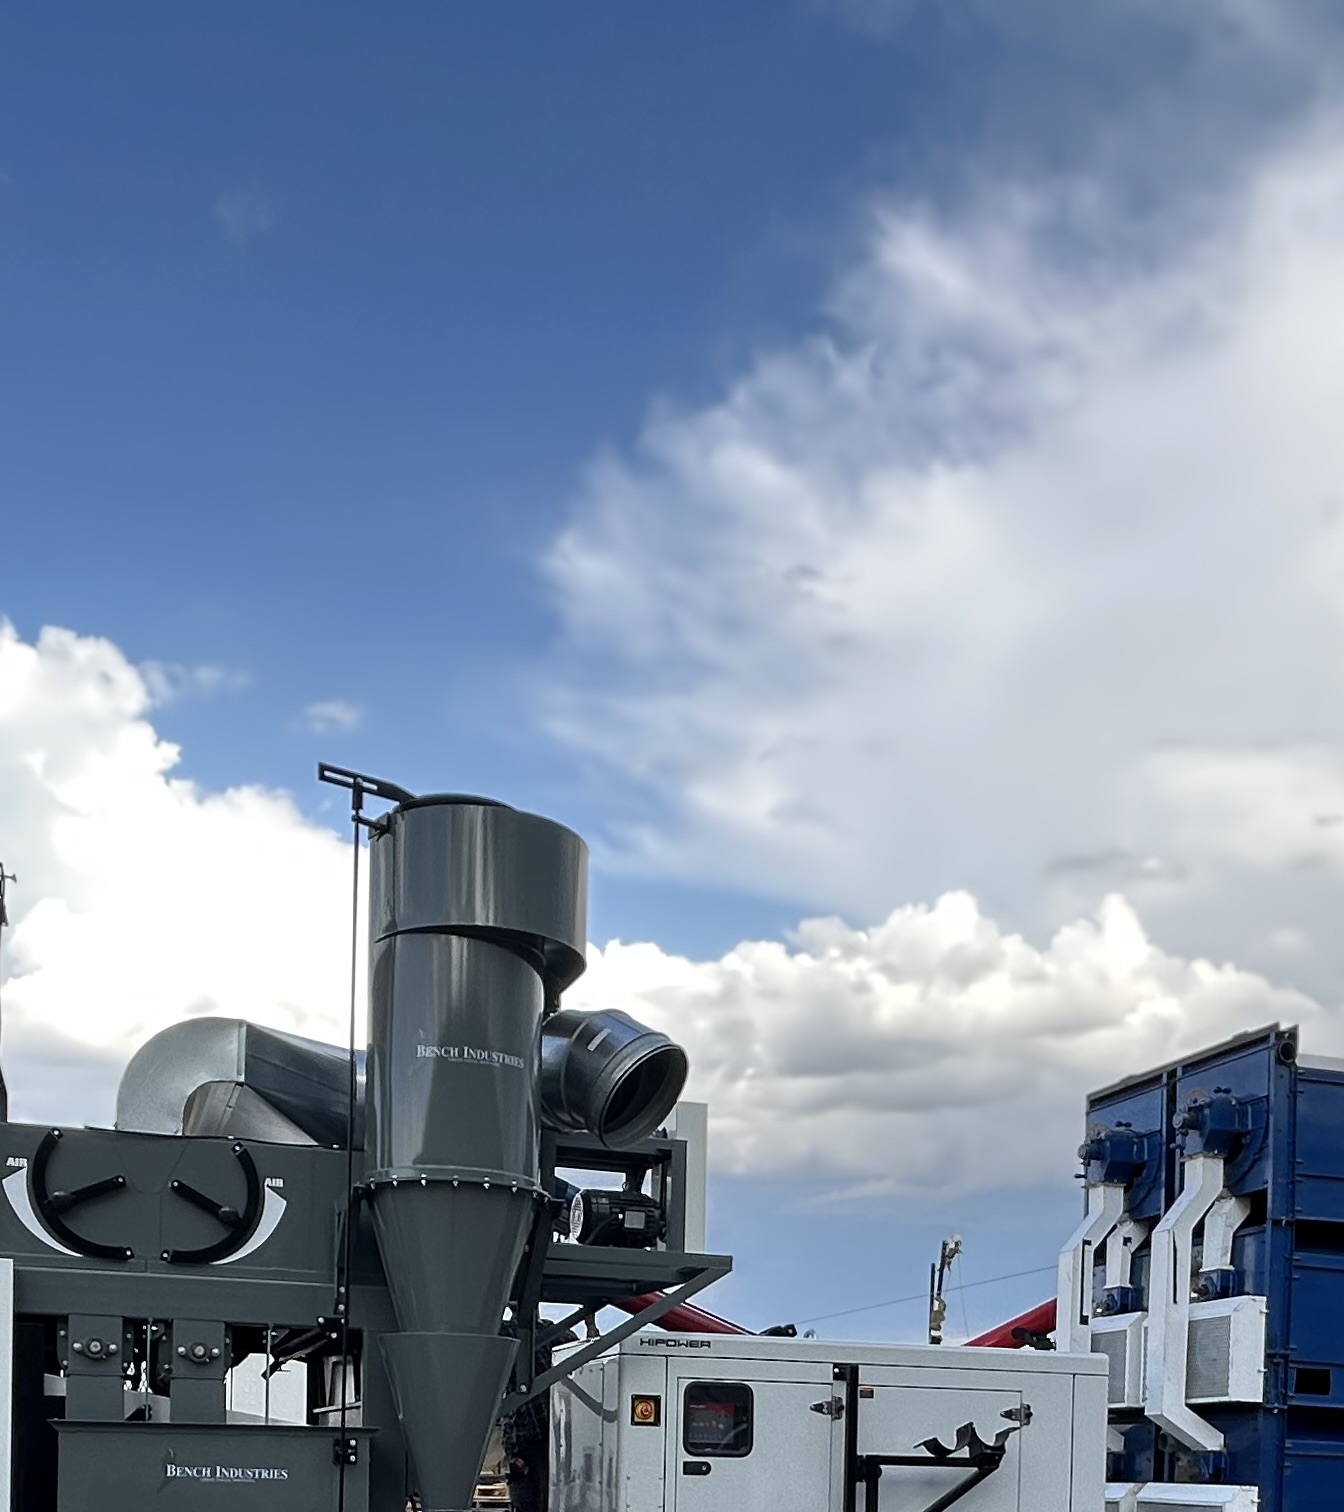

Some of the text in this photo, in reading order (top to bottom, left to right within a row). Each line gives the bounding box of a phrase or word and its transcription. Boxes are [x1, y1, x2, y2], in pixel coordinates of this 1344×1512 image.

[416, 1044, 459, 1058] BENCH
[463, 1046, 524, 1069] INDUSTRIES
[640, 1338, 711, 1349] HIPOWER
[166, 1463, 288, 1480] BENCH INDUSTRIES
